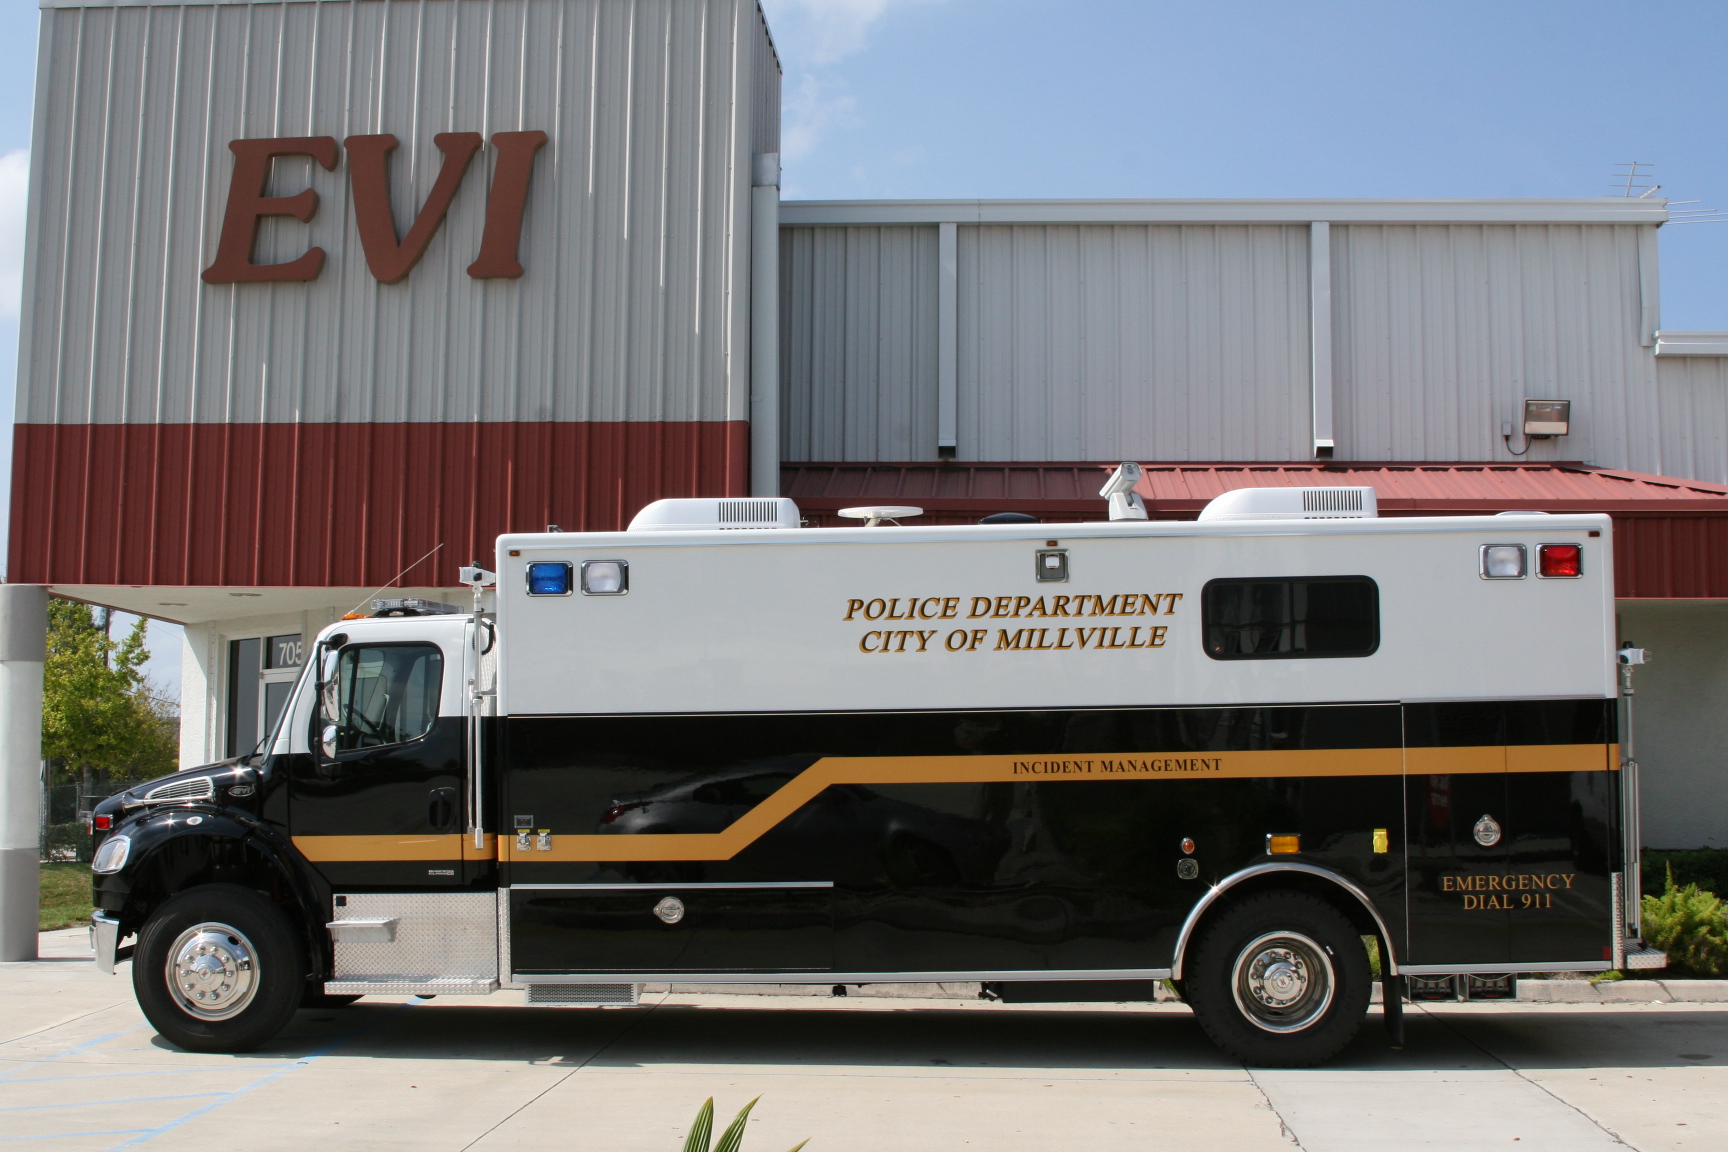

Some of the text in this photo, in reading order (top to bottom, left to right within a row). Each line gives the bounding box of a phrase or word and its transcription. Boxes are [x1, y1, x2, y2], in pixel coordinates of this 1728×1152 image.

[201, 130, 549, 285] EVI
[843, 593, 1183, 621] POLICE DEPARTMENT
[859, 626, 1168, 653] CITY OF MILLVILLE
[1013, 758, 1222, 775] INCIDENT MANAGEMENT
[1442, 873, 1576, 892] EMERGENCY
[1463, 893, 1552, 910] DIAL 911
